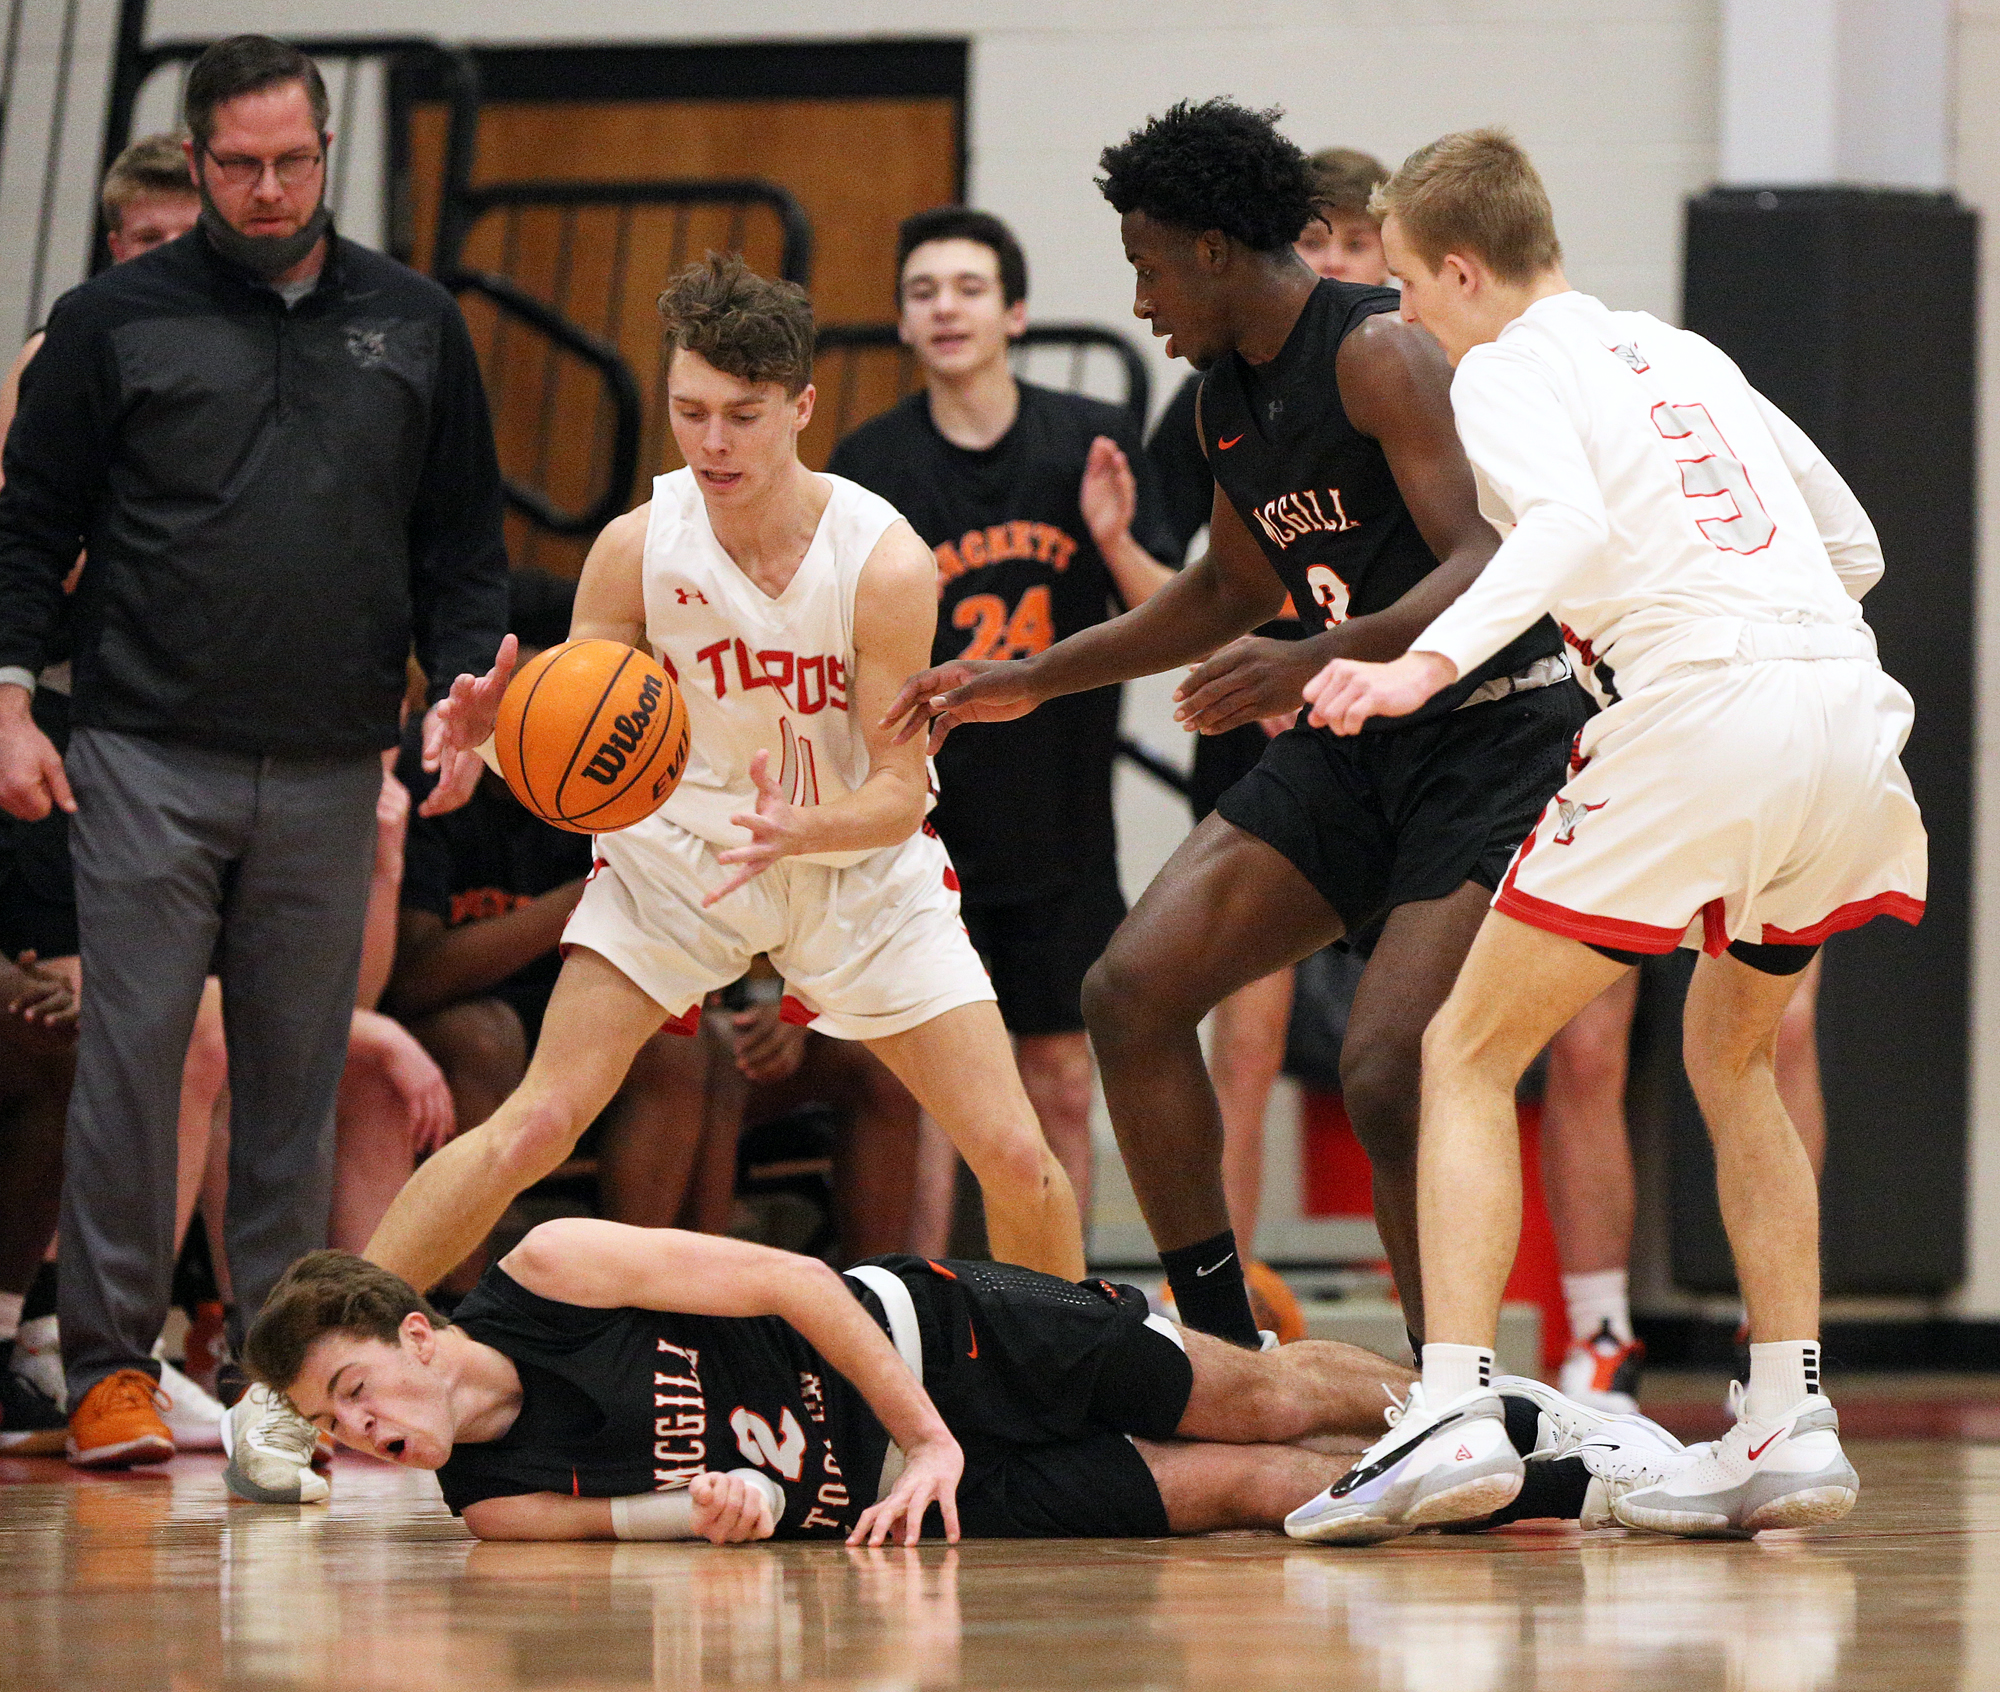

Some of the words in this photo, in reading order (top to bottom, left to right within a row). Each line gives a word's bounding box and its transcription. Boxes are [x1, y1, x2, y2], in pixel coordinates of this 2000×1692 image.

[951, 583, 1056, 661] 24
[1305, 563, 1354, 631] 3
[580, 673, 663, 786] Wilson
[728, 1405, 808, 1483] 2
